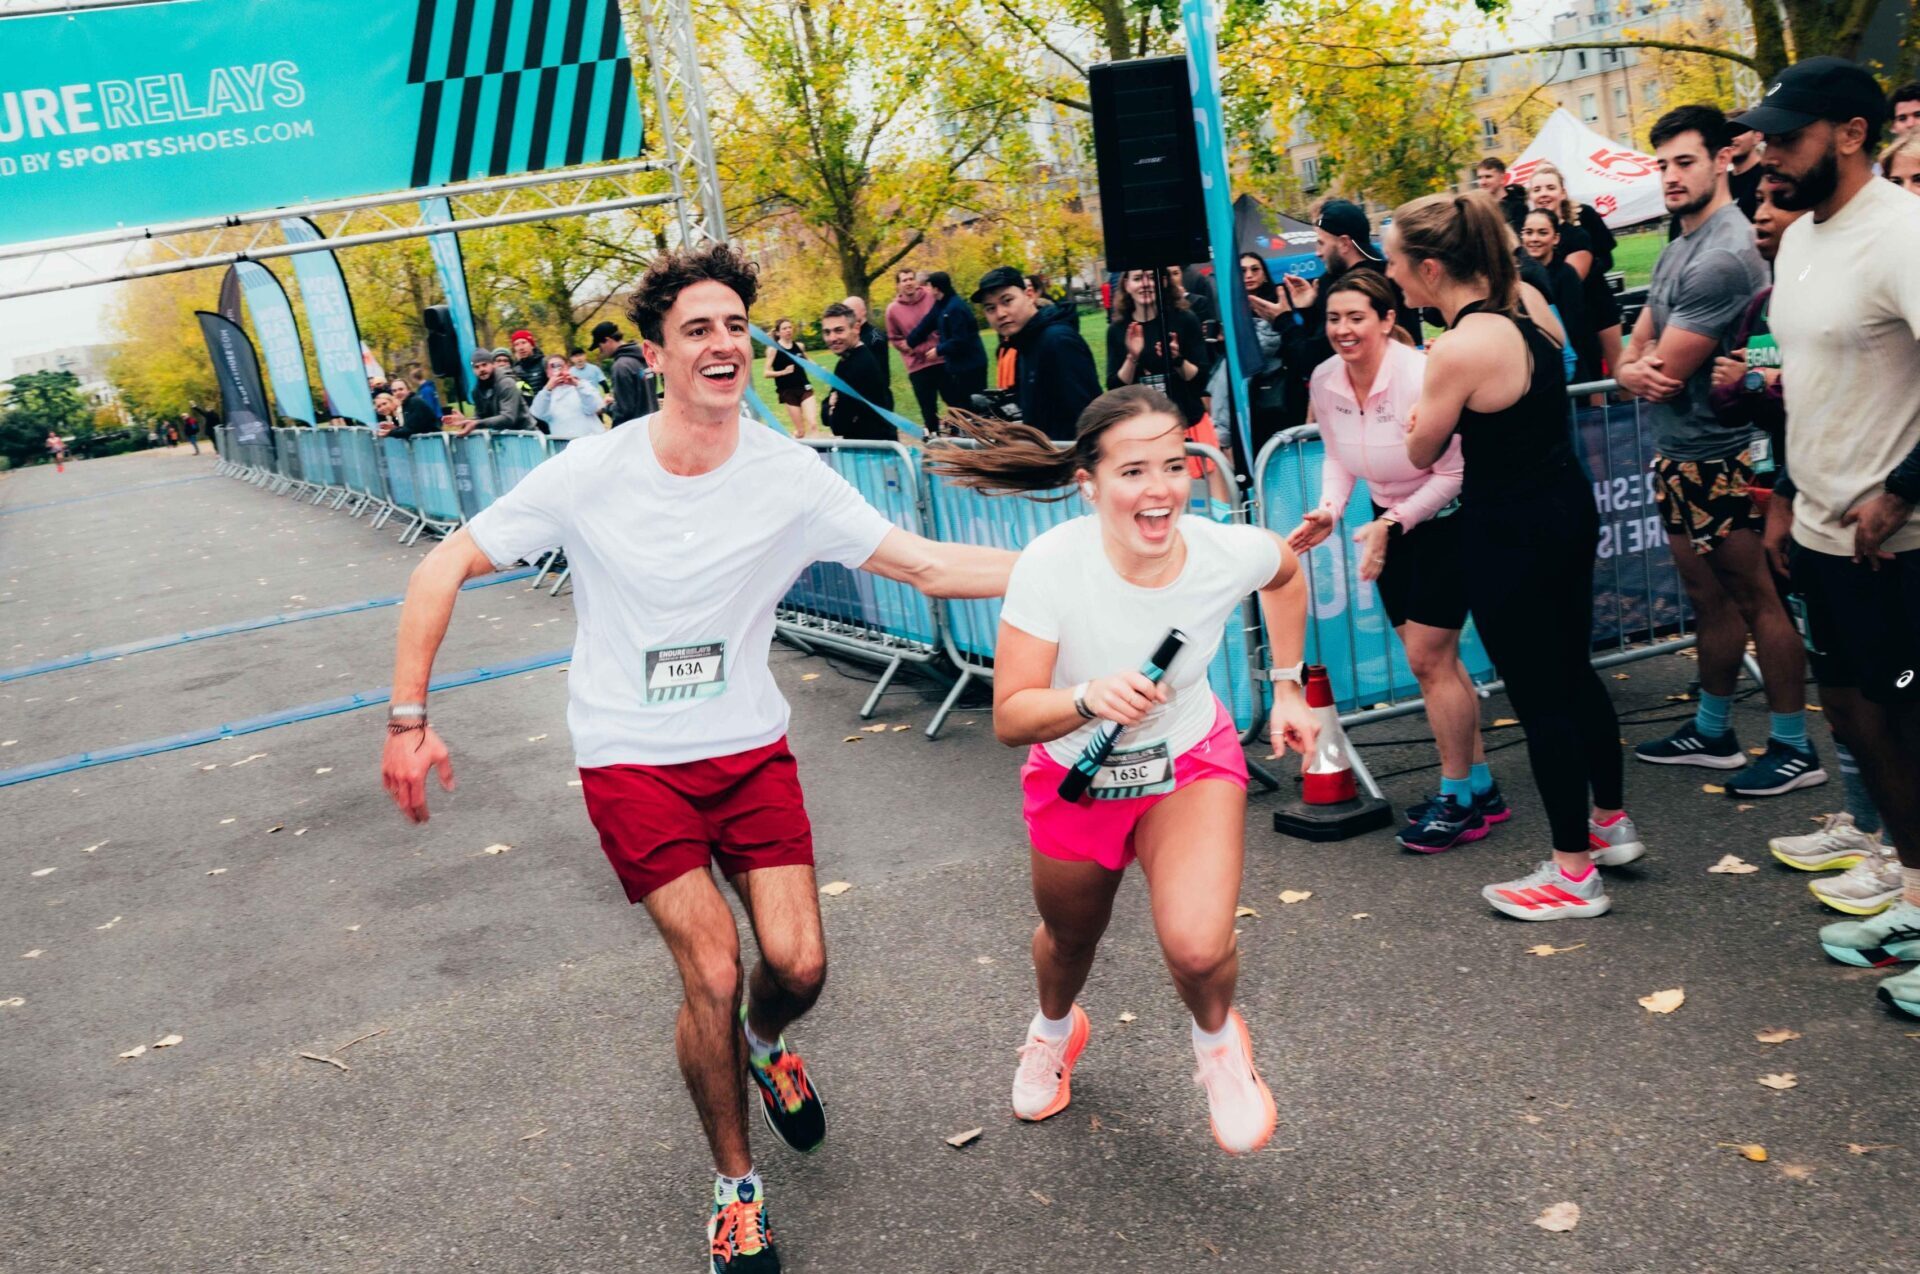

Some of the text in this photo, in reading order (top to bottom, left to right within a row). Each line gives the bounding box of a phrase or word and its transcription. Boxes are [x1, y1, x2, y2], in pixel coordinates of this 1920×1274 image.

[0, 119, 315, 176] D BY SPORTSSHOES.COM
[668, 661, 703, 677] 163A
[1110, 765, 1149, 782] 163C
